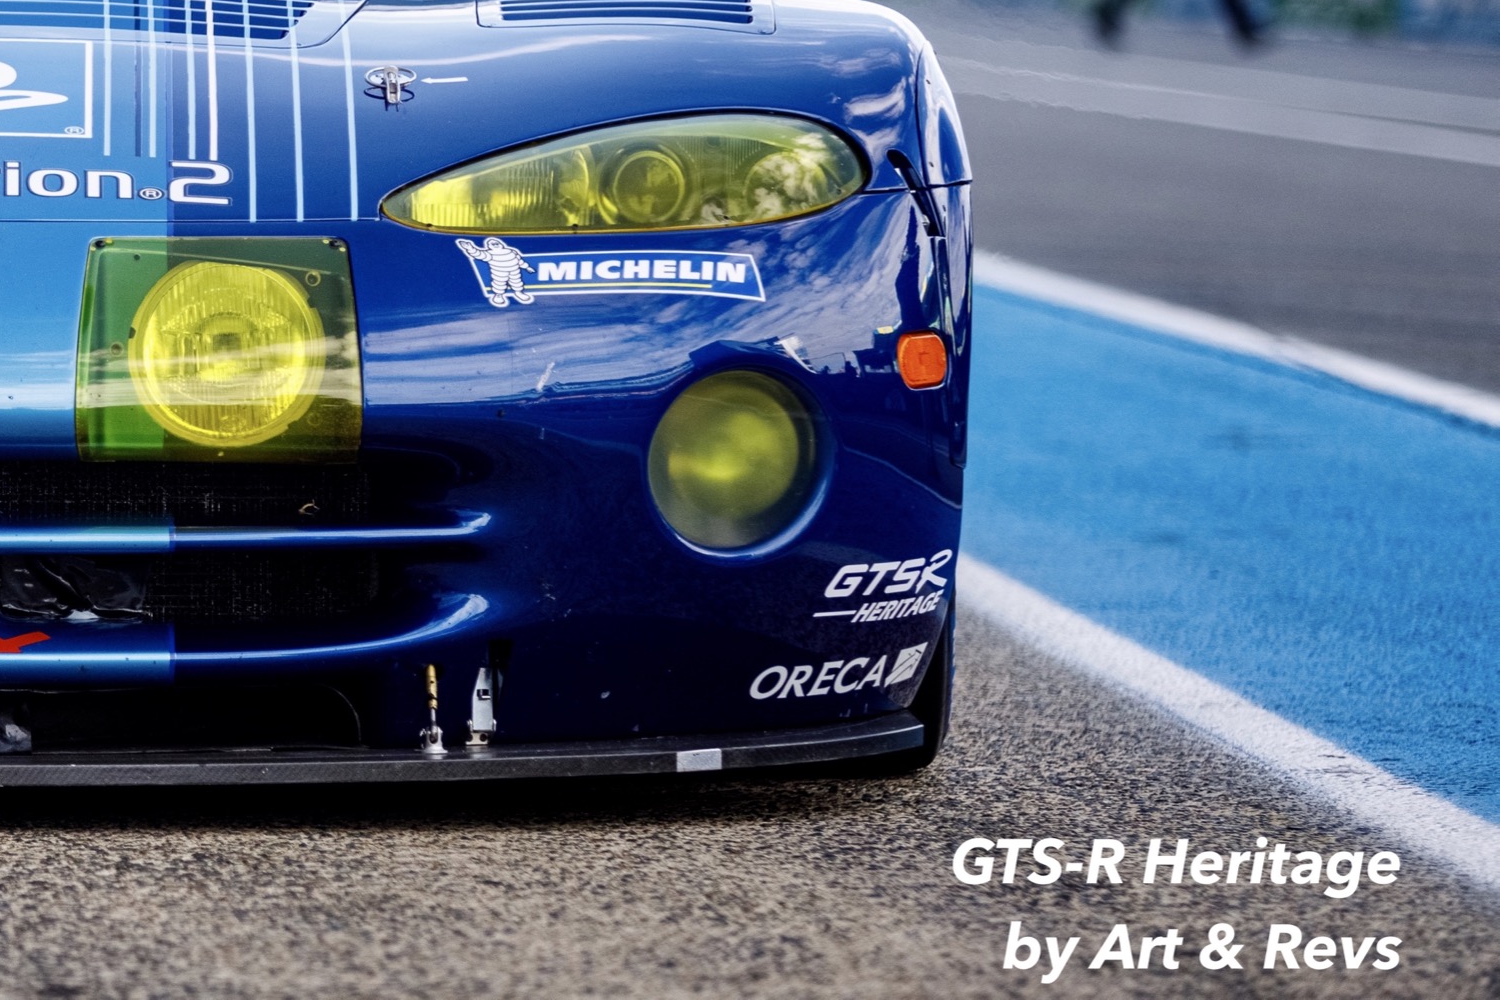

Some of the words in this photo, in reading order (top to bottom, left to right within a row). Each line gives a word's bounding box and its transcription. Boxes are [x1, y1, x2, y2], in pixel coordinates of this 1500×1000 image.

[537, 259, 746, 284] MICHELIN
[824, 548, 953, 598] GTSR
[851, 589, 944, 623] HERITAGE
[749, 654, 888, 700] ORECA
